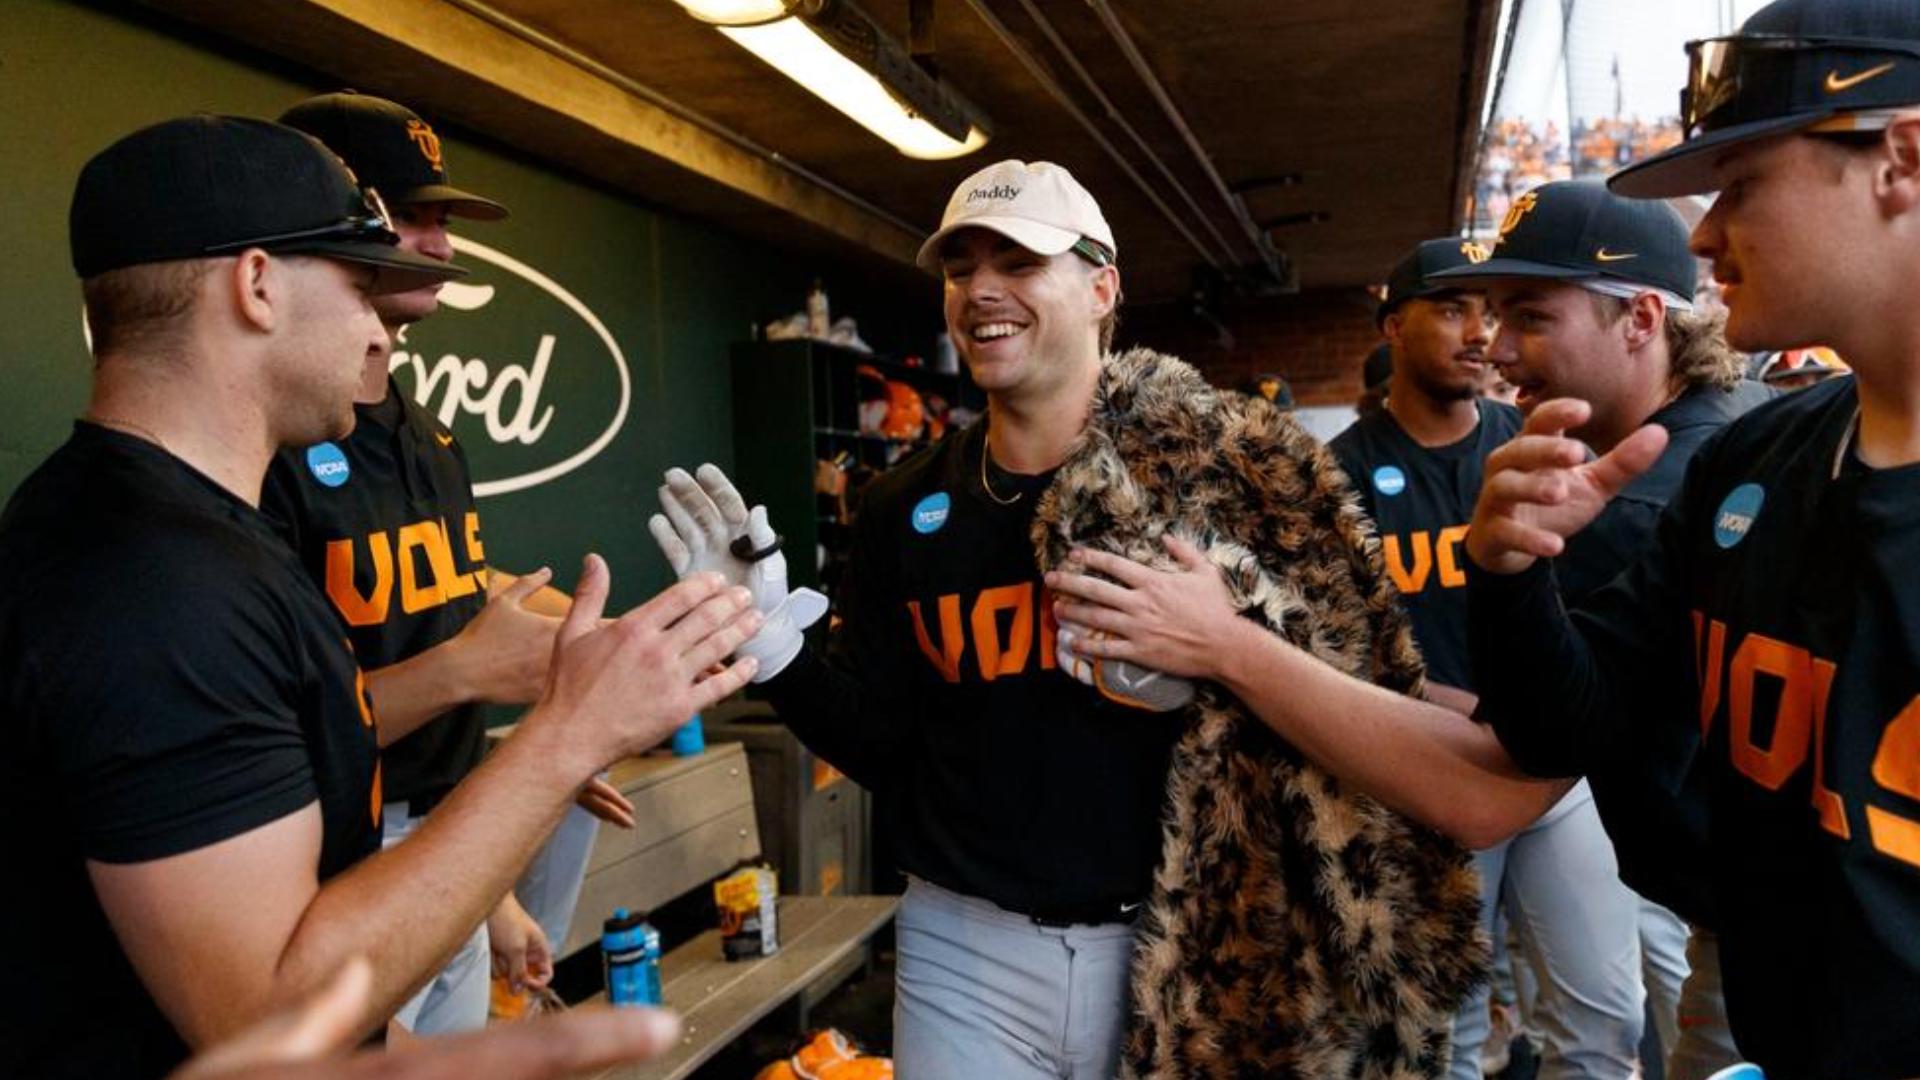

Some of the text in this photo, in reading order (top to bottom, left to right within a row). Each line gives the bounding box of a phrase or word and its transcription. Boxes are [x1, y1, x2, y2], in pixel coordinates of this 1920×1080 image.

[967, 184, 1022, 202] Daddy
[388, 281, 556, 444] ord
[1383, 524, 1472, 593] VO
